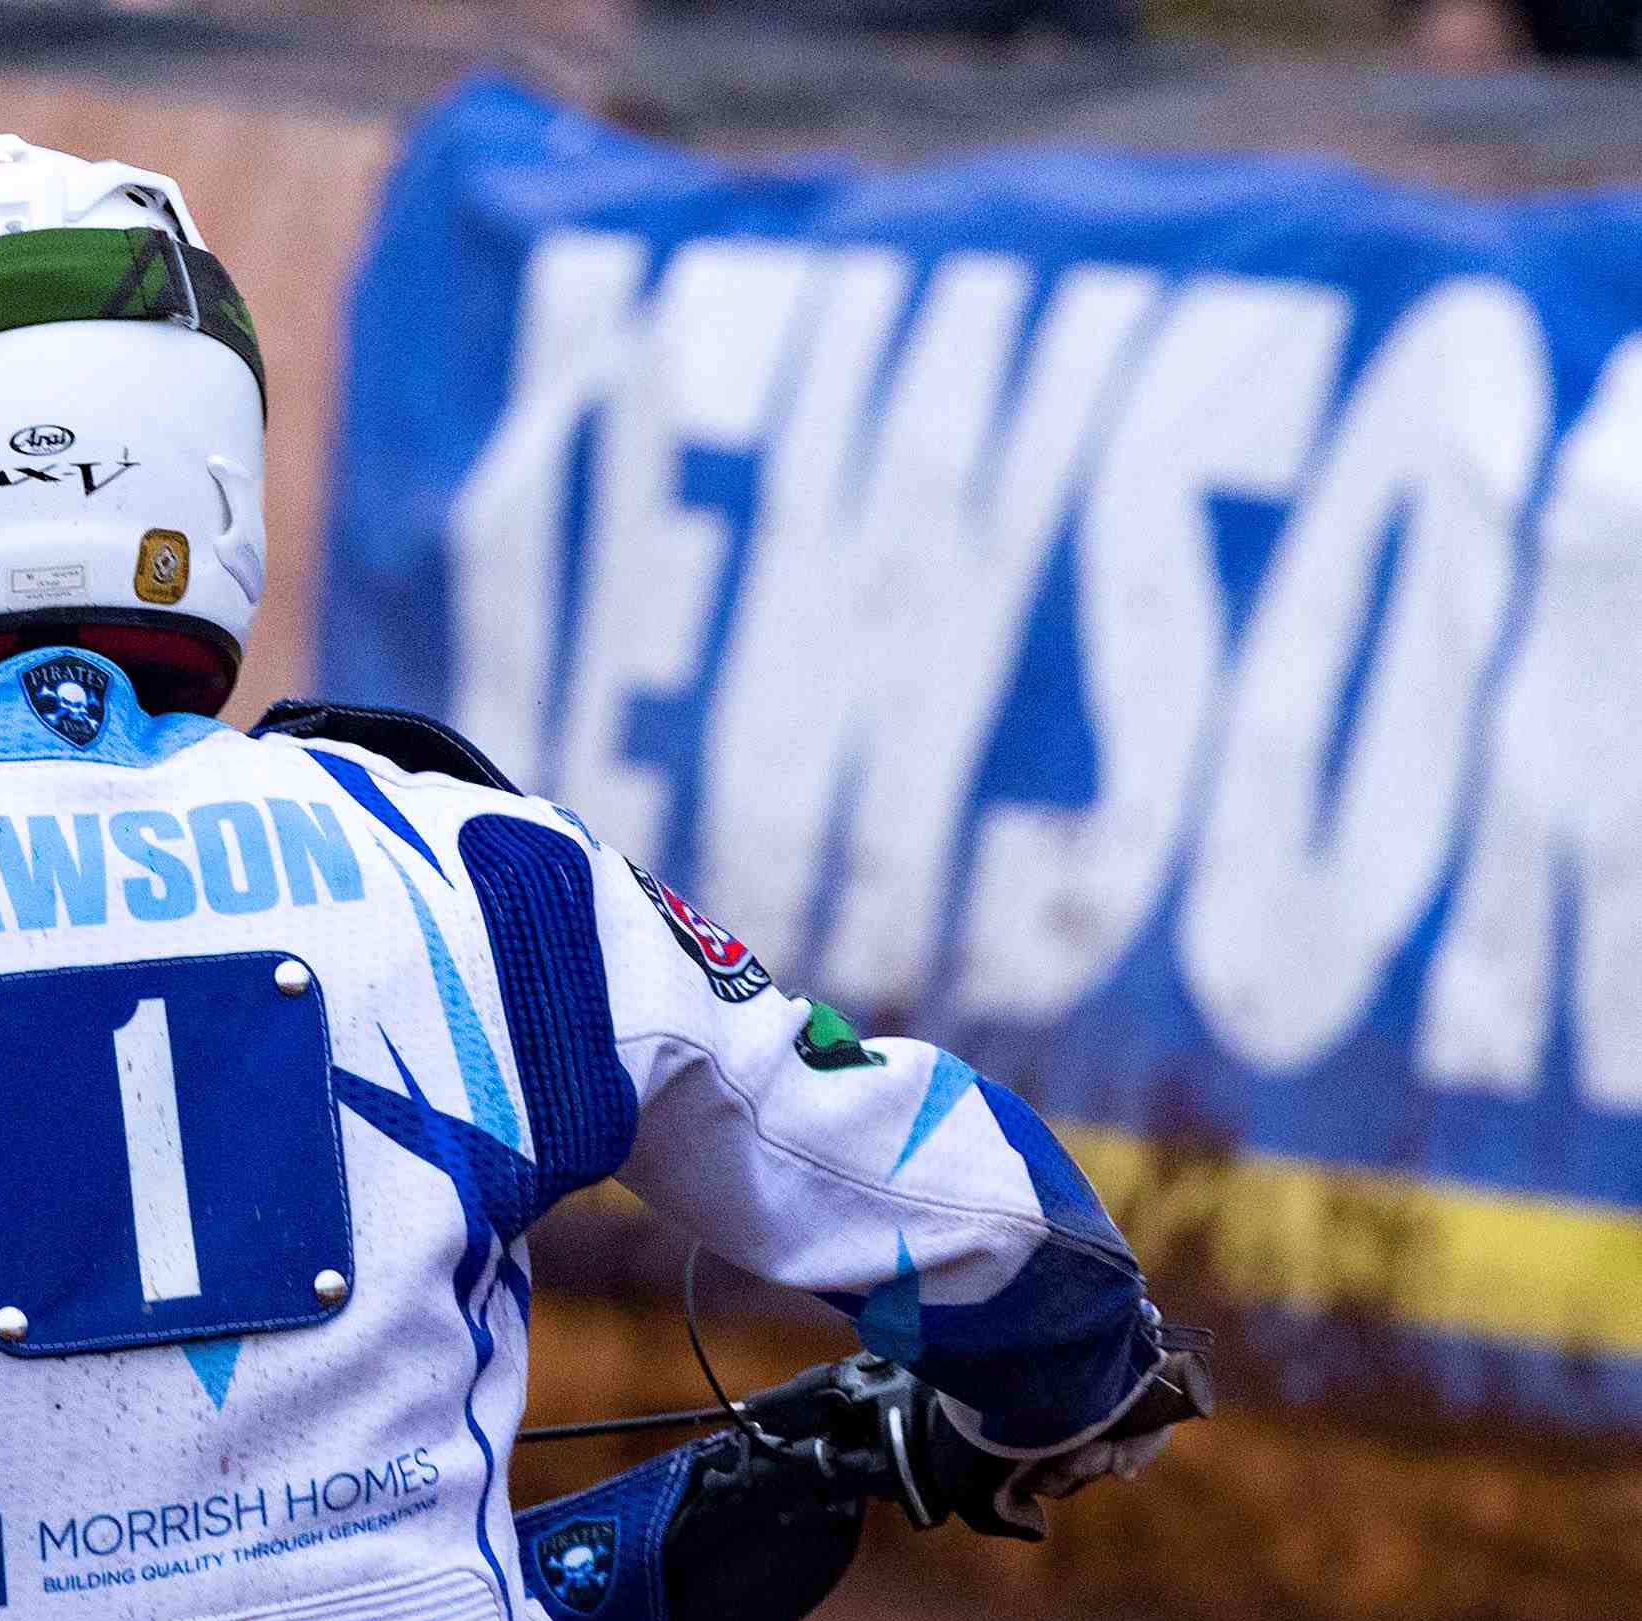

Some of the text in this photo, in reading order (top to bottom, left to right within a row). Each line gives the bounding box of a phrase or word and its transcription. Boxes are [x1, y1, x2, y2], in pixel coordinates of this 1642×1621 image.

[29, 663, 106, 690] PIRATES
[112, 997, 202, 1303] 1
[37, 1446, 440, 1563] MORRISH HOMES
[43, 1566, 137, 1594] BUILDING
[141, 1551, 224, 1582] QUALITY
[233, 1533, 325, 1565] THROUGH
